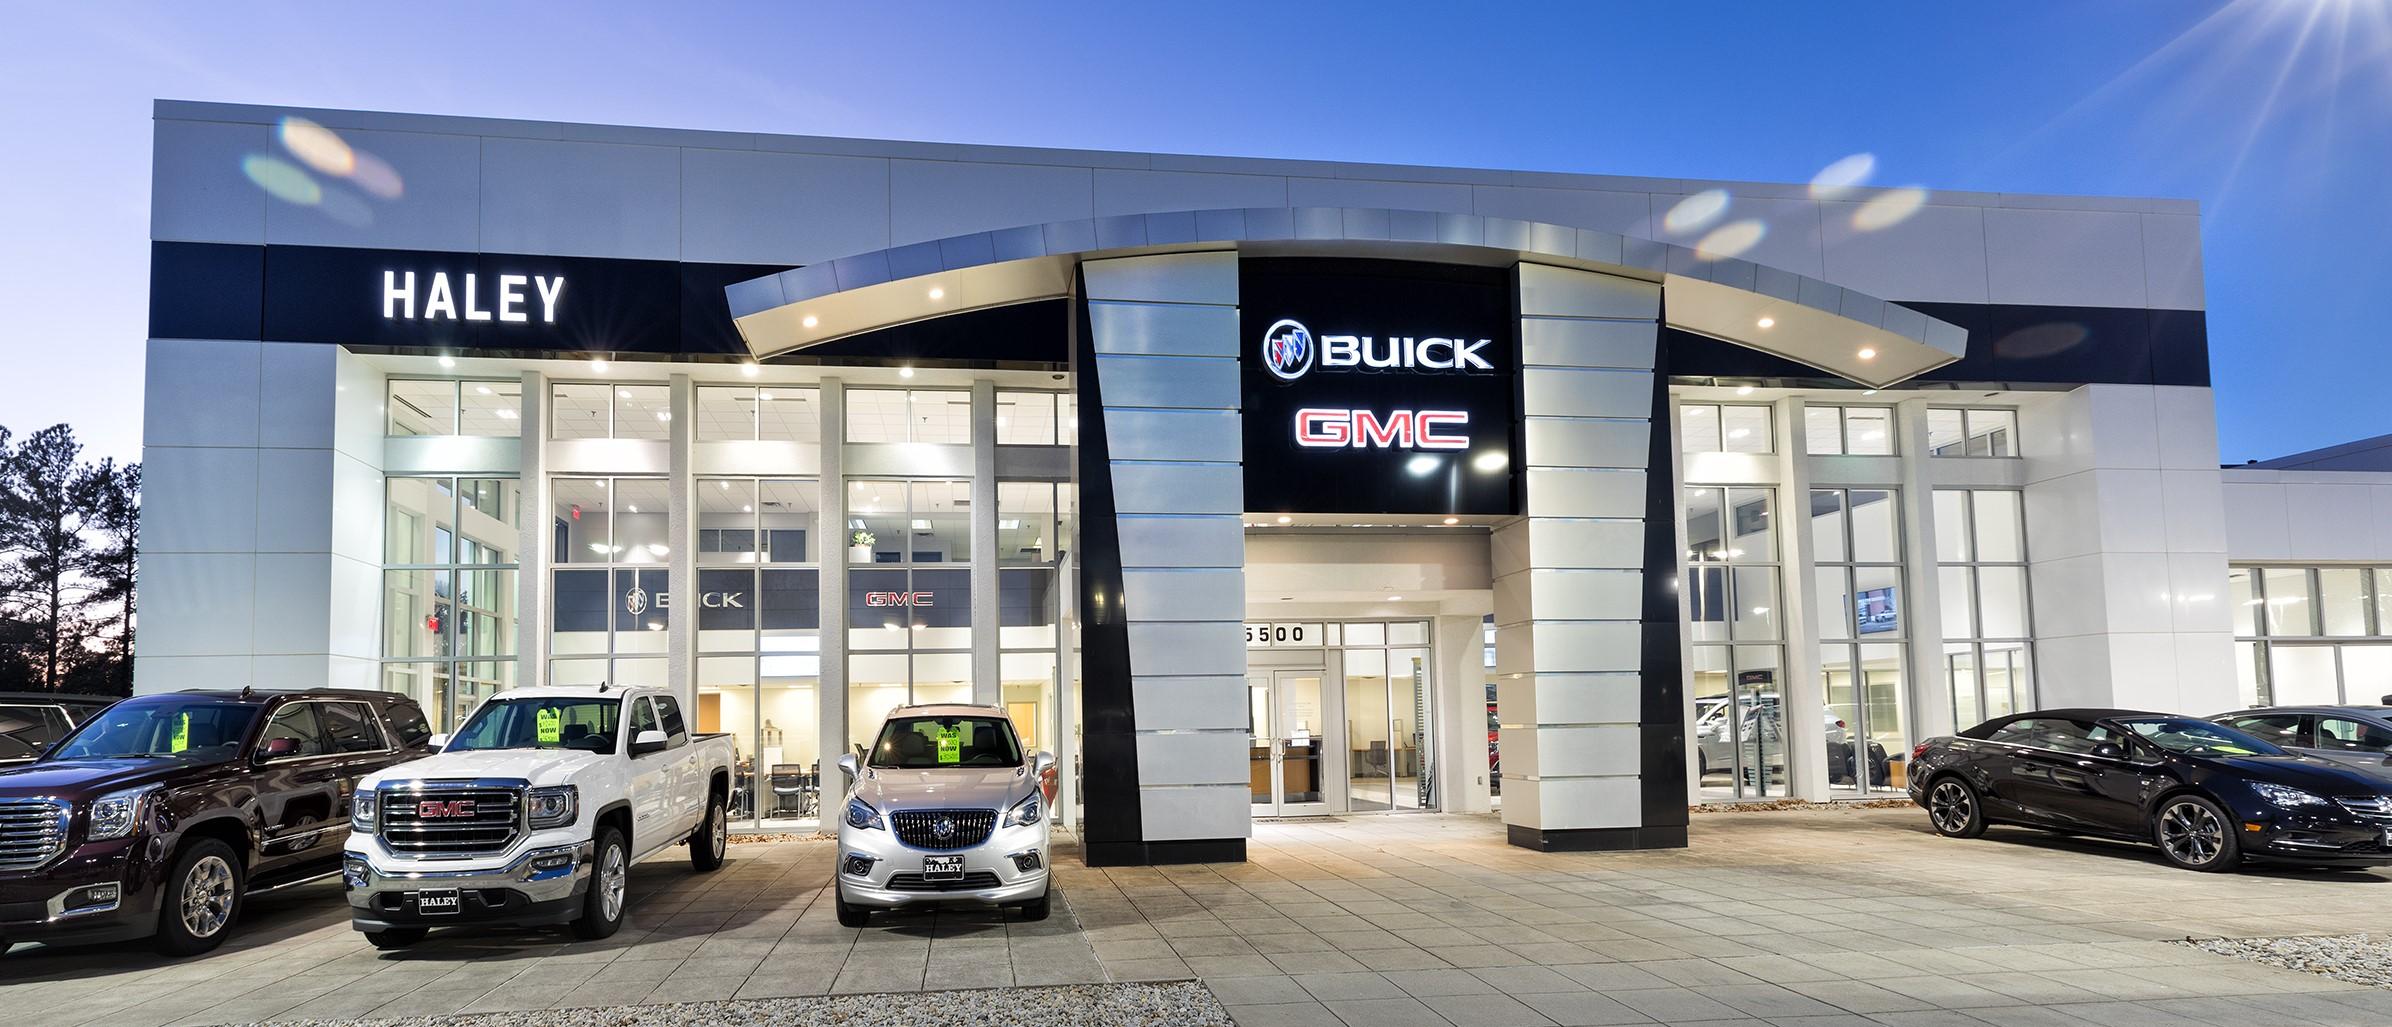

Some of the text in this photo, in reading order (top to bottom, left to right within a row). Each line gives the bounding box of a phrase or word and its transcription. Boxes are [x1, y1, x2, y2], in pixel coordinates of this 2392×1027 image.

[383, 270, 565, 322] HALEY
[1320, 335, 1494, 369] BUICK
[1295, 408, 1470, 449] GMC
[656, 592, 743, 608] BCK
[865, 591, 934, 607] GMC
[1246, 626, 1303, 642] 5500
[419, 800, 475, 818] GMC
[925, 863, 962, 873] HALEY
[420, 896, 457, 907] HALEY
